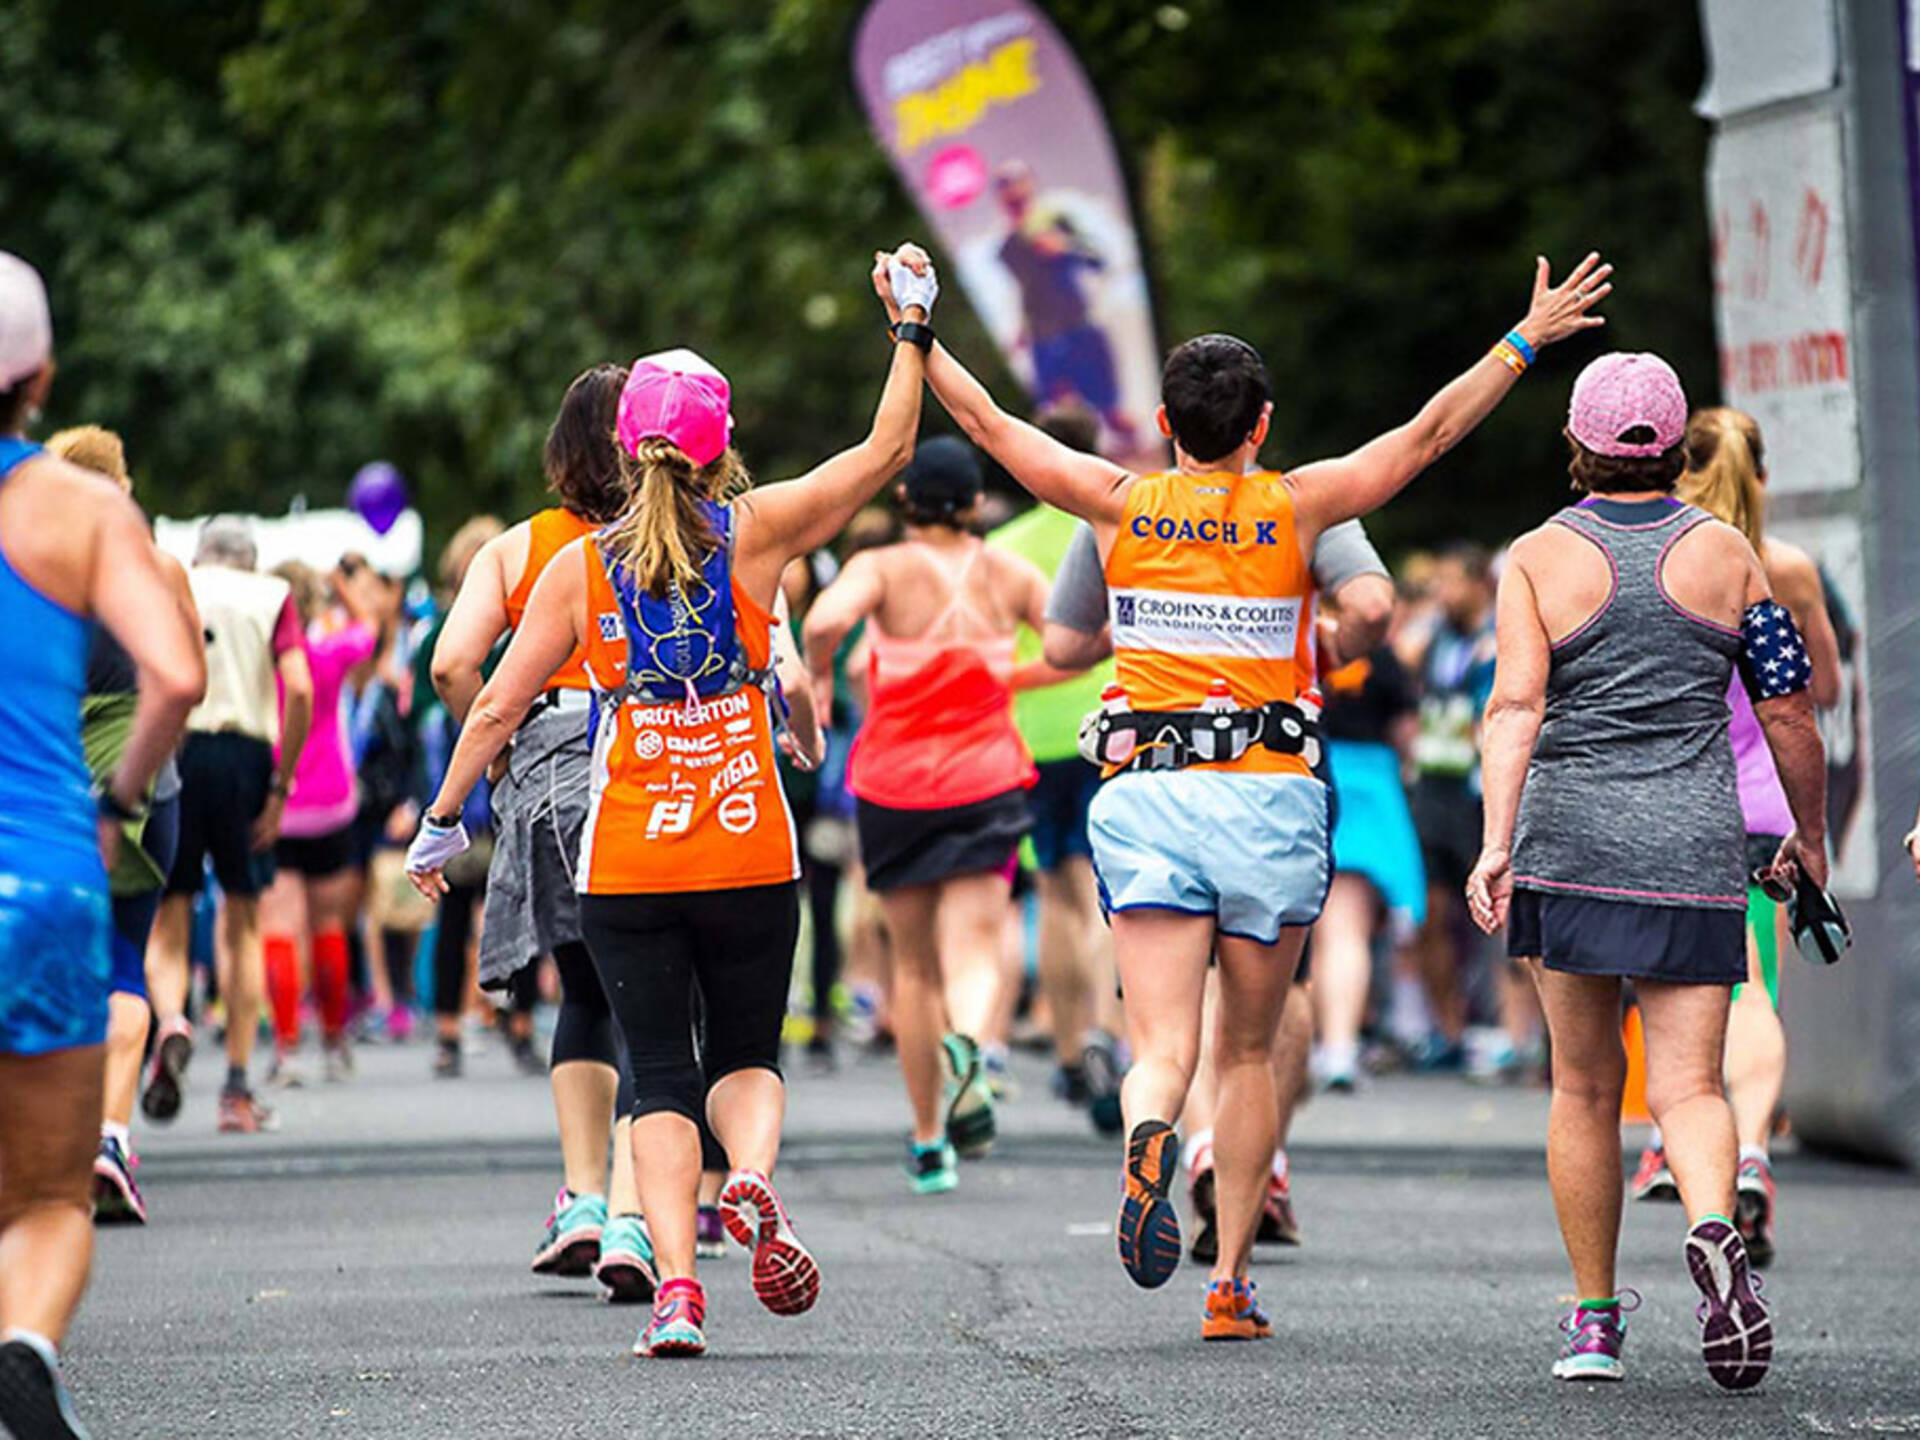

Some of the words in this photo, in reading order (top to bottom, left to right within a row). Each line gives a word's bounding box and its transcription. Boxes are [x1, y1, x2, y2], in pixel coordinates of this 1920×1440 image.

[1131, 515, 1238, 544] COACH
[1255, 521, 1277, 545] K
[1220, 605, 1232, 620] &
[1235, 606, 1294, 622] COLITS
[1138, 617, 1223, 632] FOUNDATION
